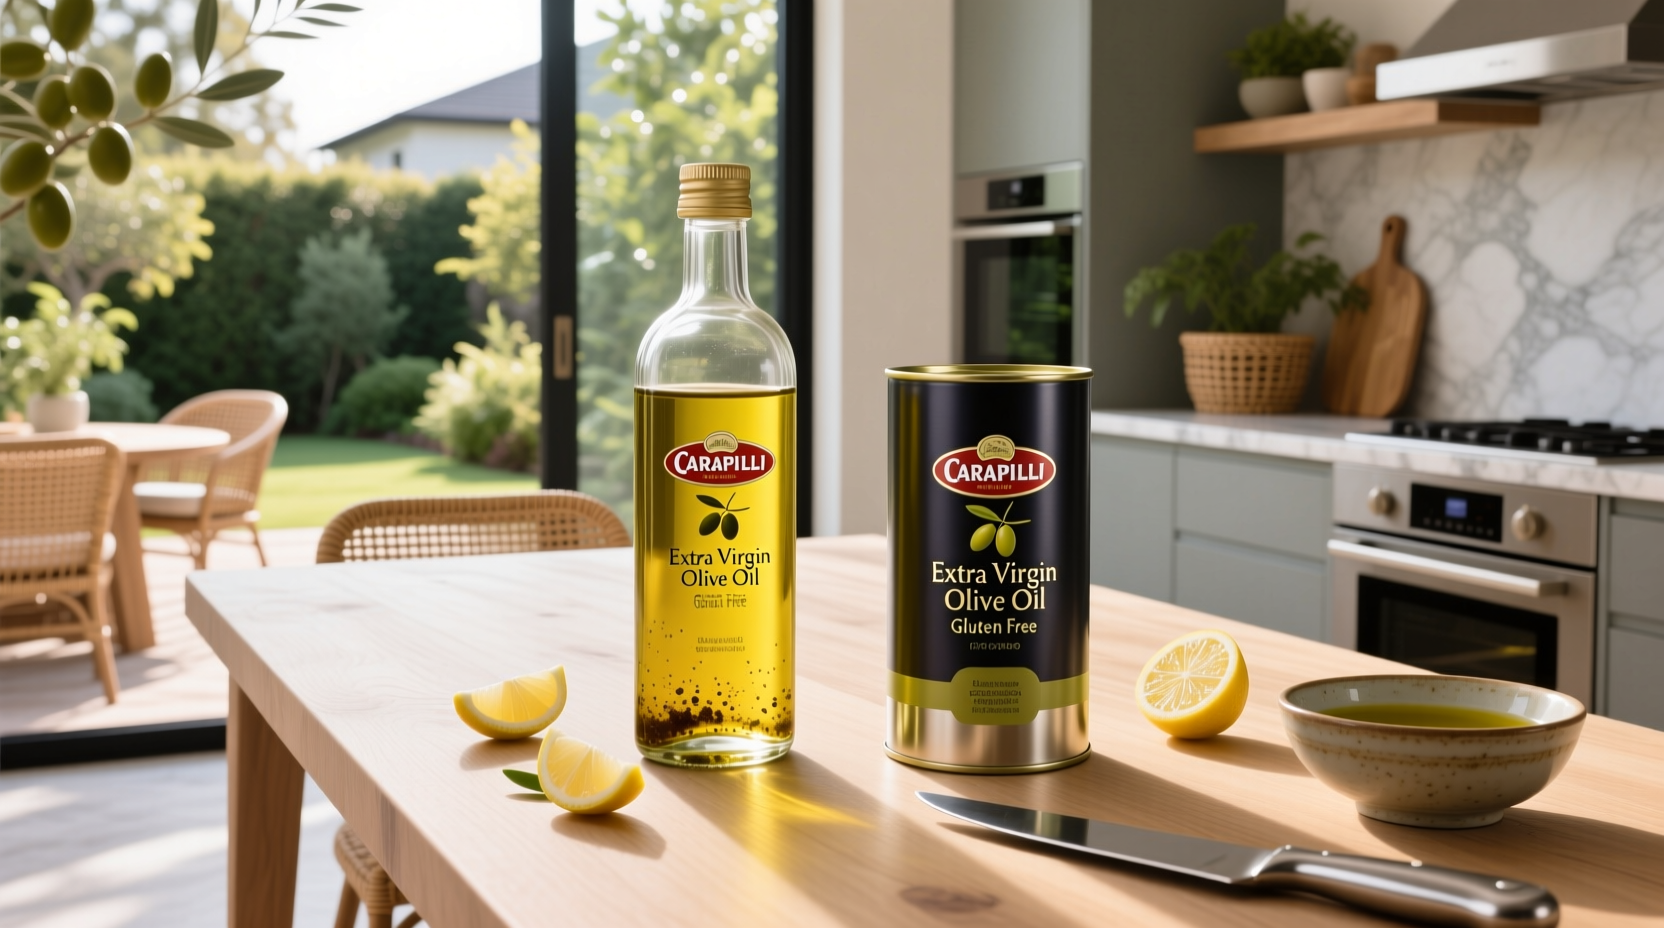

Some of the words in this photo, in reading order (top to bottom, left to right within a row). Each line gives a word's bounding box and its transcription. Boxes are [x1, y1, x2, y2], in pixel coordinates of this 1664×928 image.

[674, 450, 766, 475] CARAPILLI
[943, 457, 1045, 483] CARAPILLI
[669, 547, 713, 566] Extra
[717, 547, 771, 570] Virgin
[681, 569, 728, 587] Olive
[732, 567, 760, 586] Oil
[931, 561, 987, 584] Extra
[991, 561, 1057, 589] Virgin
[944, 587, 1006, 612] Olive
[1011, 586, 1046, 611] Oil
[950, 617, 1002, 635] Gluten
[1007, 617, 1038, 634] Free
